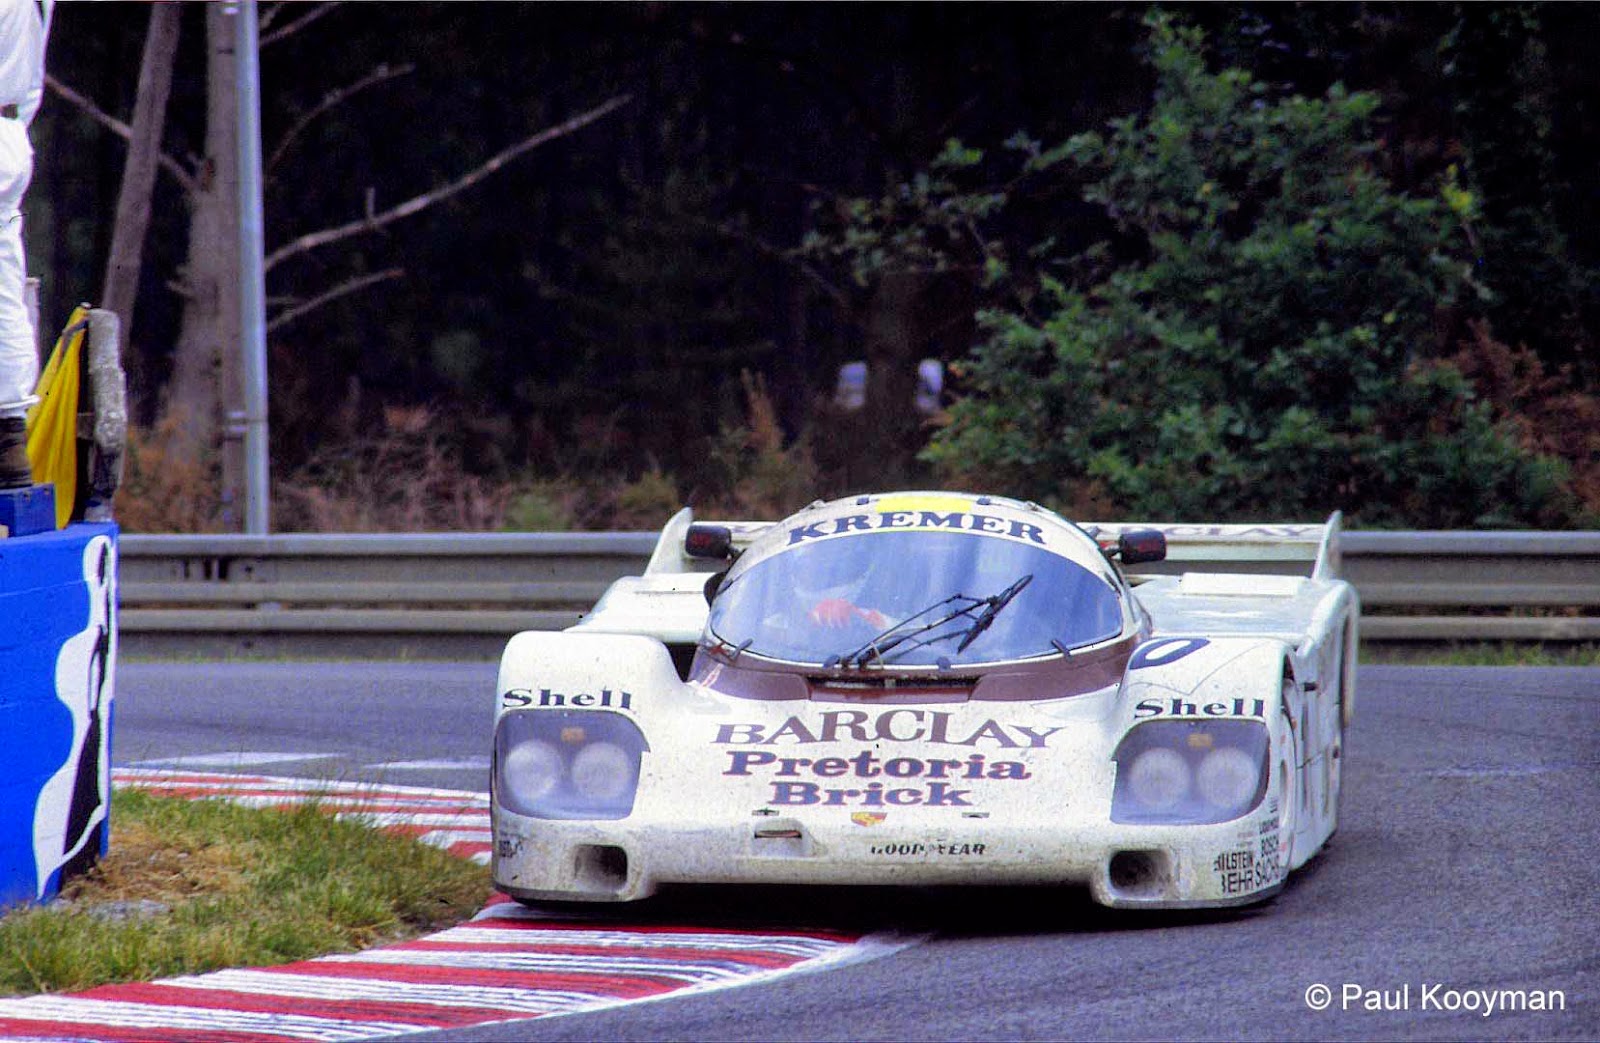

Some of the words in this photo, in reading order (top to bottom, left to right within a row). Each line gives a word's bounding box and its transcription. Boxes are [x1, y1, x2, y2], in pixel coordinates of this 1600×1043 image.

[786, 511, 1047, 546] KREMER
[502, 688, 632, 710] Shell
[1134, 698, 1264, 718] Shell
[710, 709, 1065, 748] BARCLAY
[722, 751, 1032, 780] Pretoria
[767, 781, 973, 806] Brick
